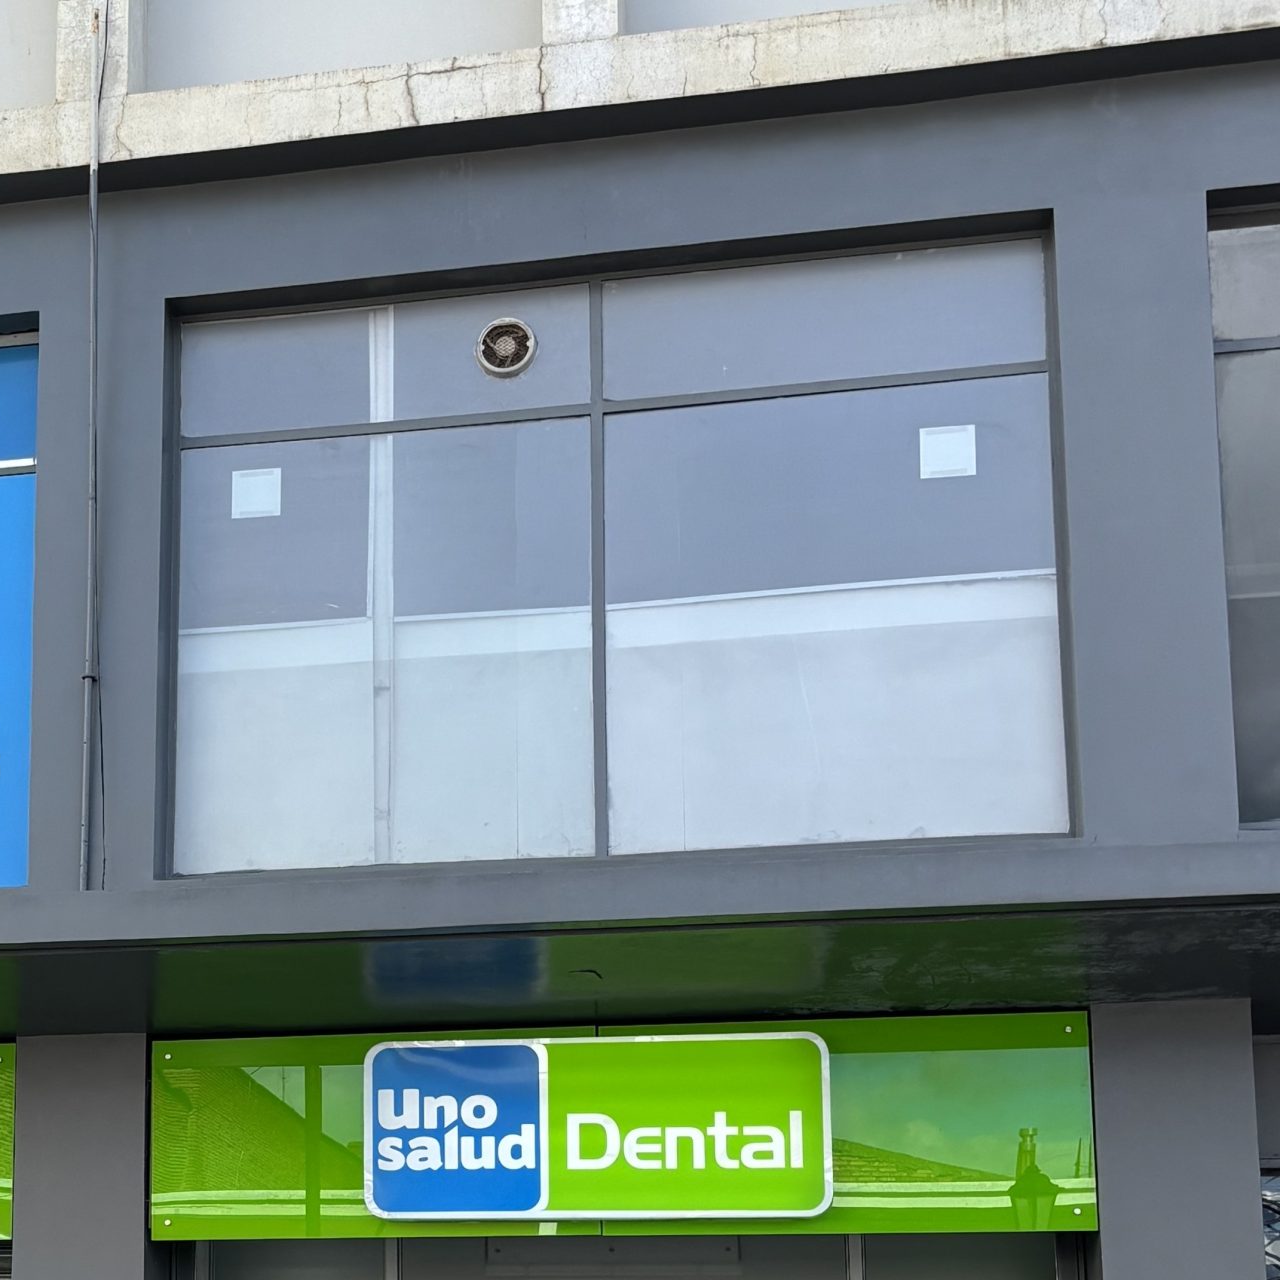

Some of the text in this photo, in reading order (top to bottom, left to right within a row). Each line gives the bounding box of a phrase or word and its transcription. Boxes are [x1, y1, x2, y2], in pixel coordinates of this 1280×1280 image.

[377, 1088, 497, 1130] Uno
[377, 1123, 536, 1171] salud
[566, 1110, 804, 1170] Dental
